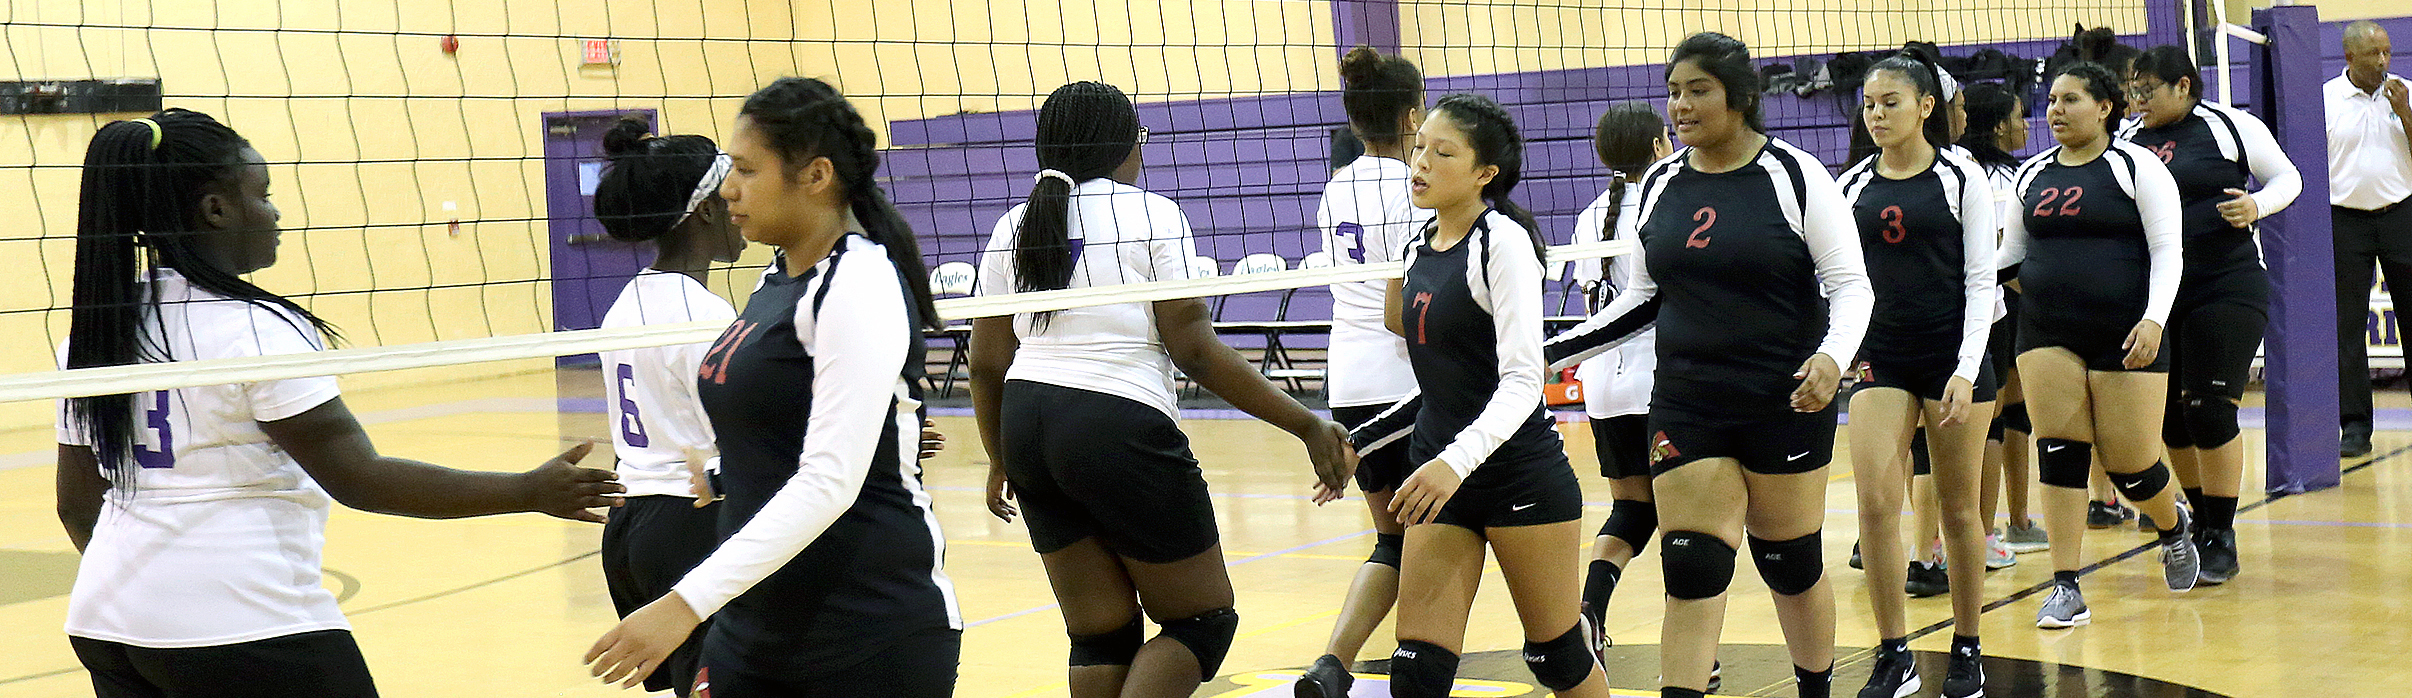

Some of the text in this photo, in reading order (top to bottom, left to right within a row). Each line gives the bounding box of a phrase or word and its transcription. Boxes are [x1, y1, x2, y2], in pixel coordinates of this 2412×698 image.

[1880, 205, 1906, 243] 3
[2033, 186, 2083, 217] 22
[1686, 206, 1716, 249] 2
[1412, 291, 1433, 344] 7
[700, 319, 758, 385] 21
[617, 363, 649, 448] 6
[1565, 384, 1579, 401] G
[133, 390, 174, 469] 3
